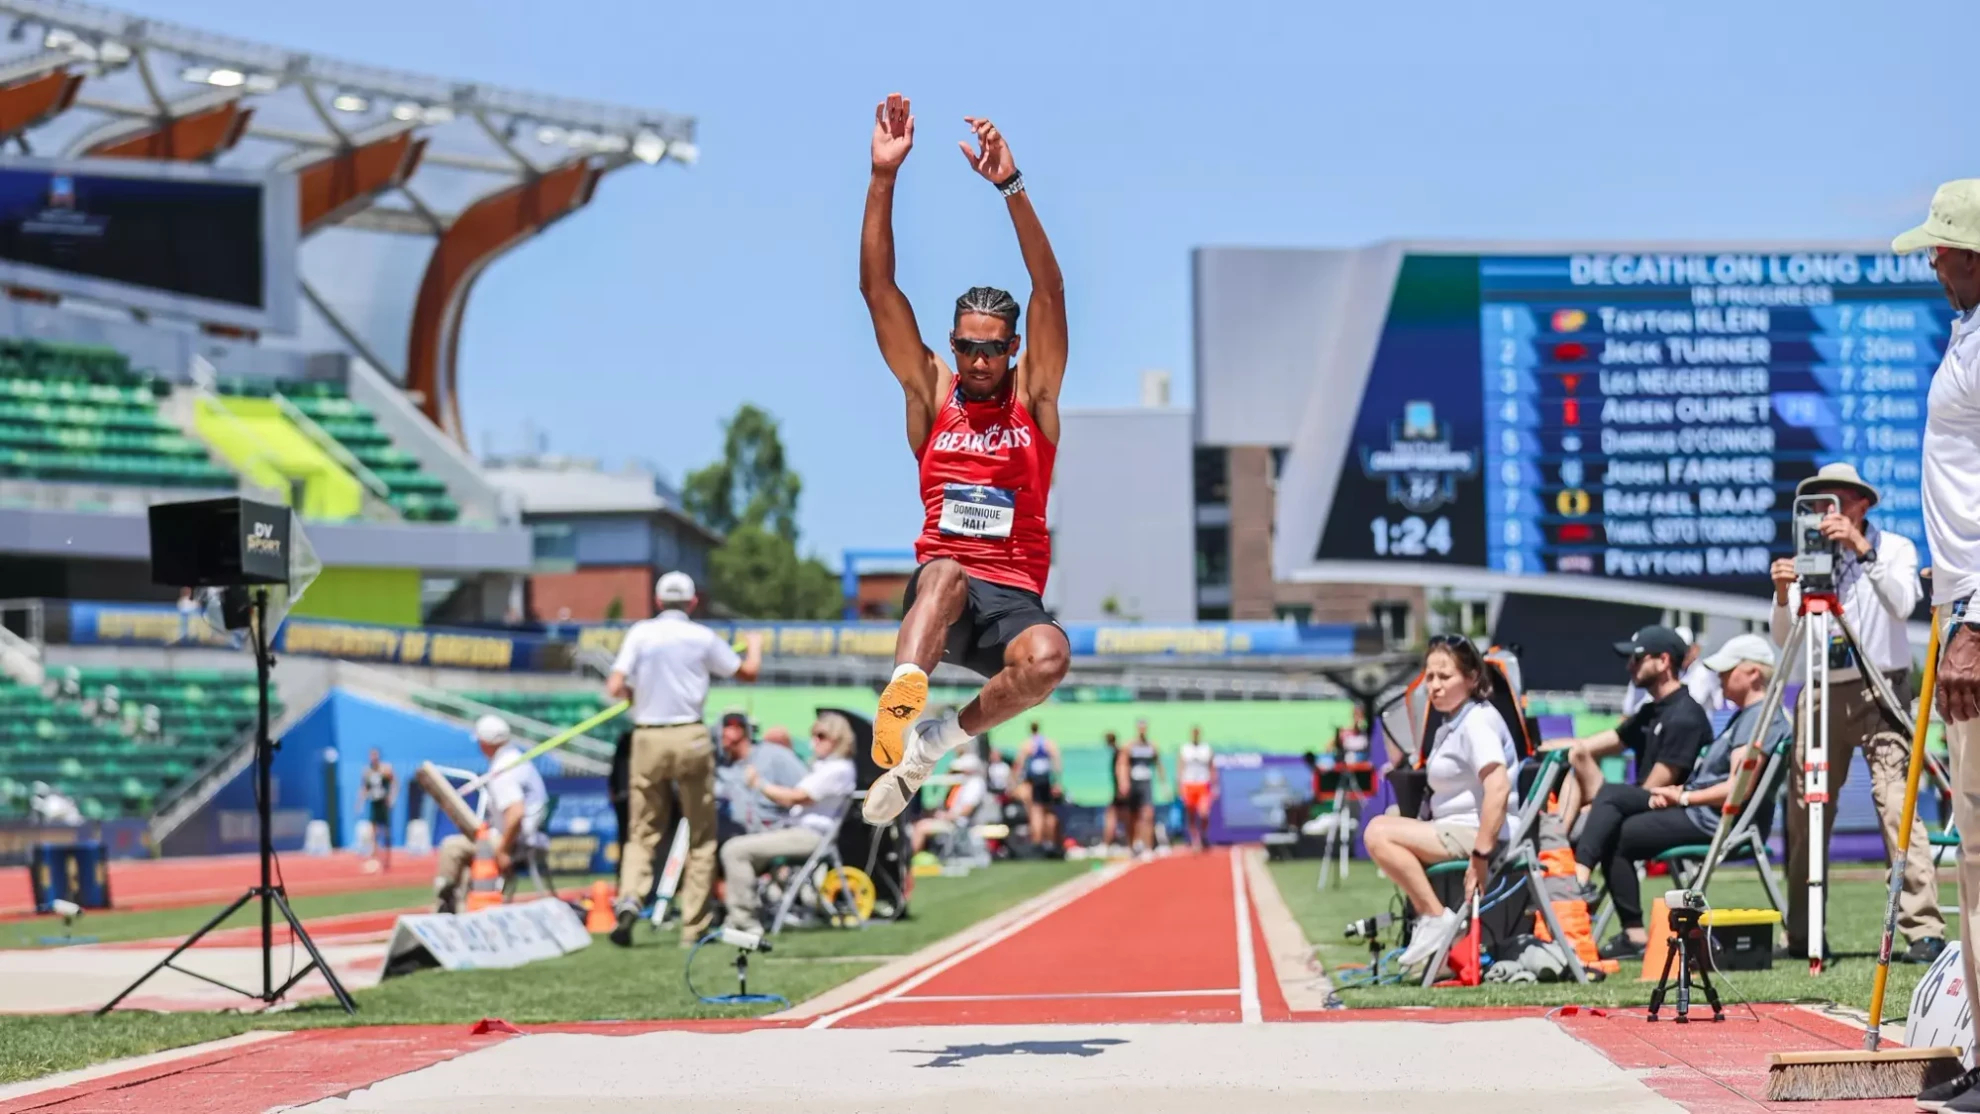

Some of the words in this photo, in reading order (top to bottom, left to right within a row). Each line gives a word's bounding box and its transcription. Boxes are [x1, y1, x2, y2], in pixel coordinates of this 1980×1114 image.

[1570, 254, 1762, 285] DECATHLON
[1769, 254, 1861, 284] LONG
[1865, 254, 1939, 283] JUM
[1691, 284, 1715, 306] IN
[1717, 284, 1834, 306] PROGRESS
[1502, 308, 1514, 333] 1
[1695, 306, 1770, 333] KLEIN
[1501, 338, 1516, 365] 2
[1665, 336, 1771, 364] TURNER
[1500, 367, 1518, 394] 3
[1637, 367, 1769, 395] NEUGEBAUER
[1499, 398, 1518, 423] 4
[1675, 396, 1770, 424] OUIMET
[933, 425, 1032, 453] BEARCATS
[1502, 428, 1520, 456] 5
[1667, 456, 1774, 485] FARMER
[954, 503, 1001, 520] DOMINIQUE
[1698, 486, 1776, 515] RAAP
[254, 521, 274, 539] DV
[962, 518, 986, 531] HALL
[1370, 516, 1453, 556] 1:24
[1706, 546, 1770, 576] BAIR
[1914, 948, 1961, 1018] 16
